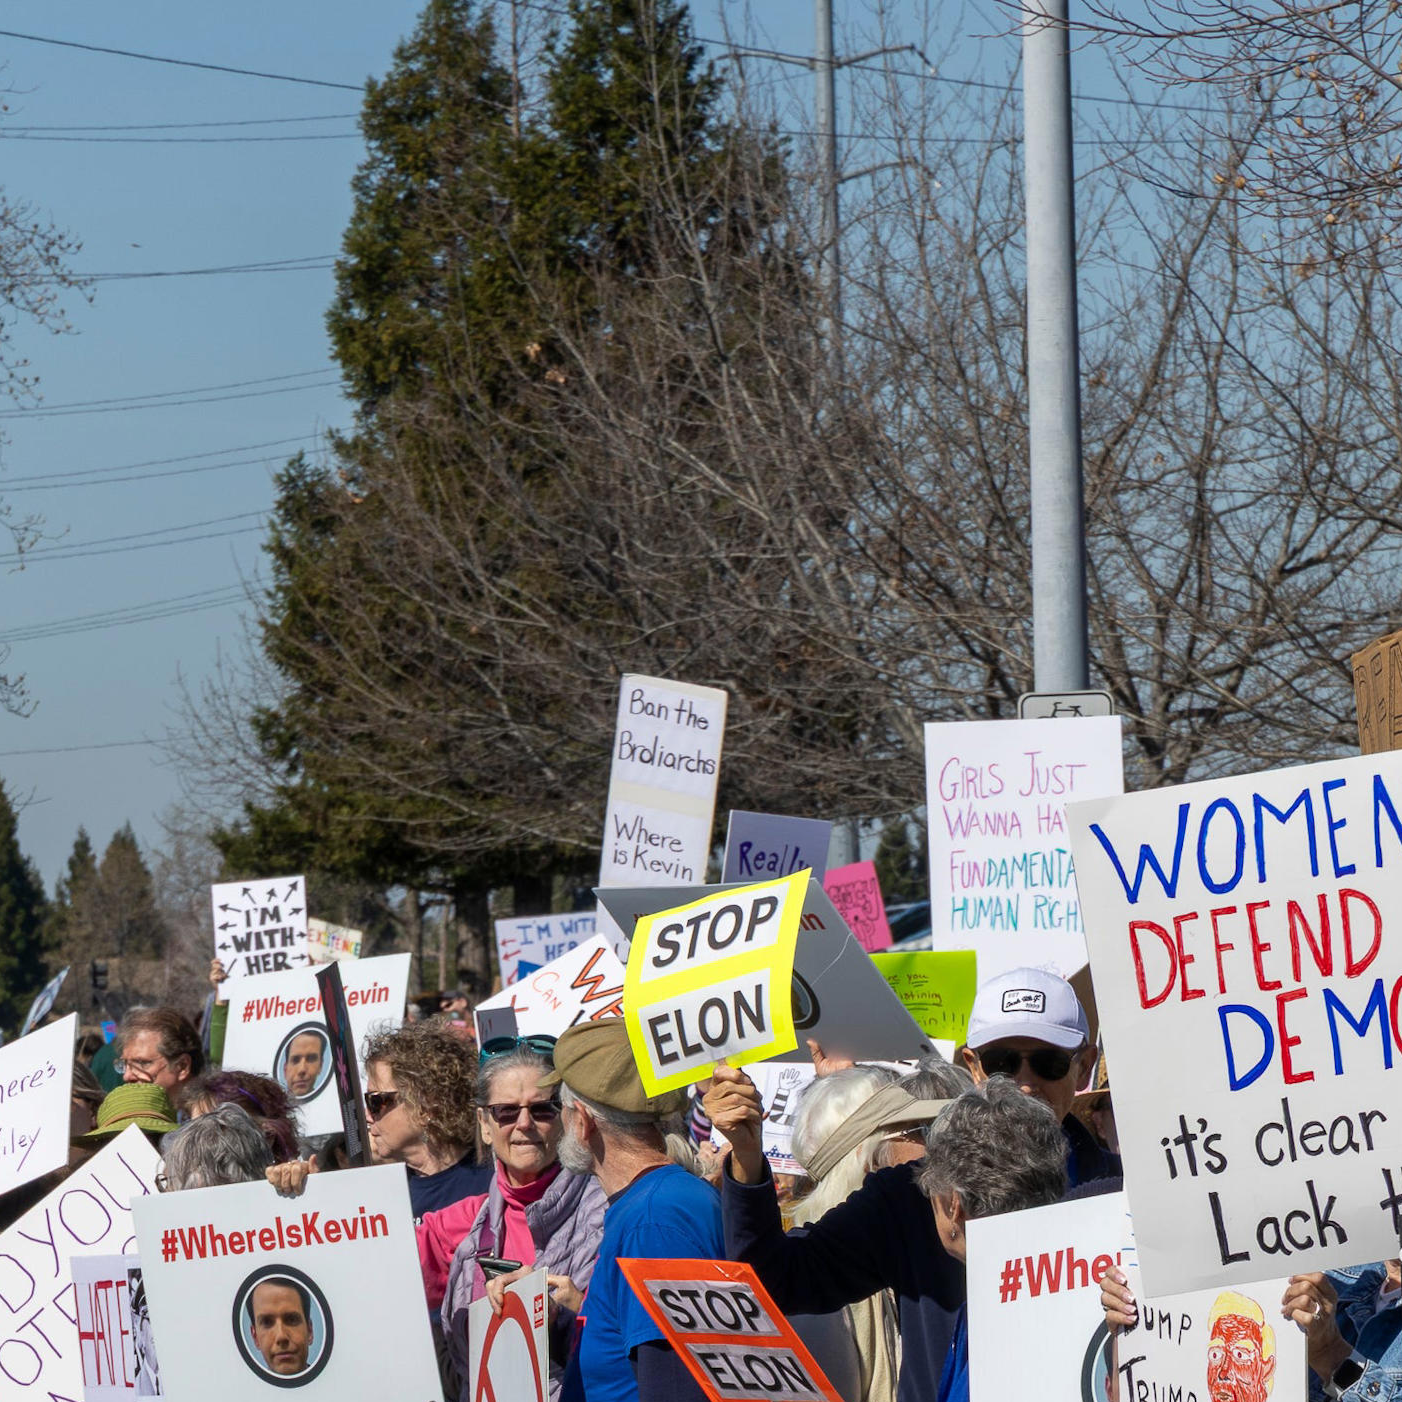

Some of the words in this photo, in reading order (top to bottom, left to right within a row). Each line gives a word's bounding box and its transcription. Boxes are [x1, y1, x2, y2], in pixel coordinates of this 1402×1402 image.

[628, 688, 670, 721] Ban
[674, 699, 710, 732] the
[938, 757, 1004, 803] GIRLS
[1018, 751, 1089, 797] JUST
[613, 813, 684, 854] Where
[942, 802, 1022, 840] WANNA
[1036, 804, 1068, 836] HA
[612, 843, 629, 869] is
[632, 845, 694, 882] Kevin
[739, 840, 810, 878] Reall
[950, 847, 1075, 892] FUNDAMENTA
[244, 905, 282, 928] I'M
[516, 922, 552, 946] I'M
[651, 895, 779, 969] STOP
[951, 894, 1019, 932] HUMAN
[231, 927, 295, 953] WITH
[1128, 887, 1384, 1010] DEFEND
[246, 951, 293, 976] HER
[242, 981, 390, 1023] #WhereIevin
[646, 984, 765, 1067] ELON
[1161, 1112, 1228, 1180] it's
[1254, 1096, 1389, 1169] clear
[18, 1152, 152, 1278] YOU
[161, 1206, 389, 1263] #WhereIsKevin
[1209, 1179, 1349, 1267] Lack
[658, 1288, 762, 1332] STOP
[74, 1280, 135, 1388] HATE
[697, 1351, 817, 1394] ELON
